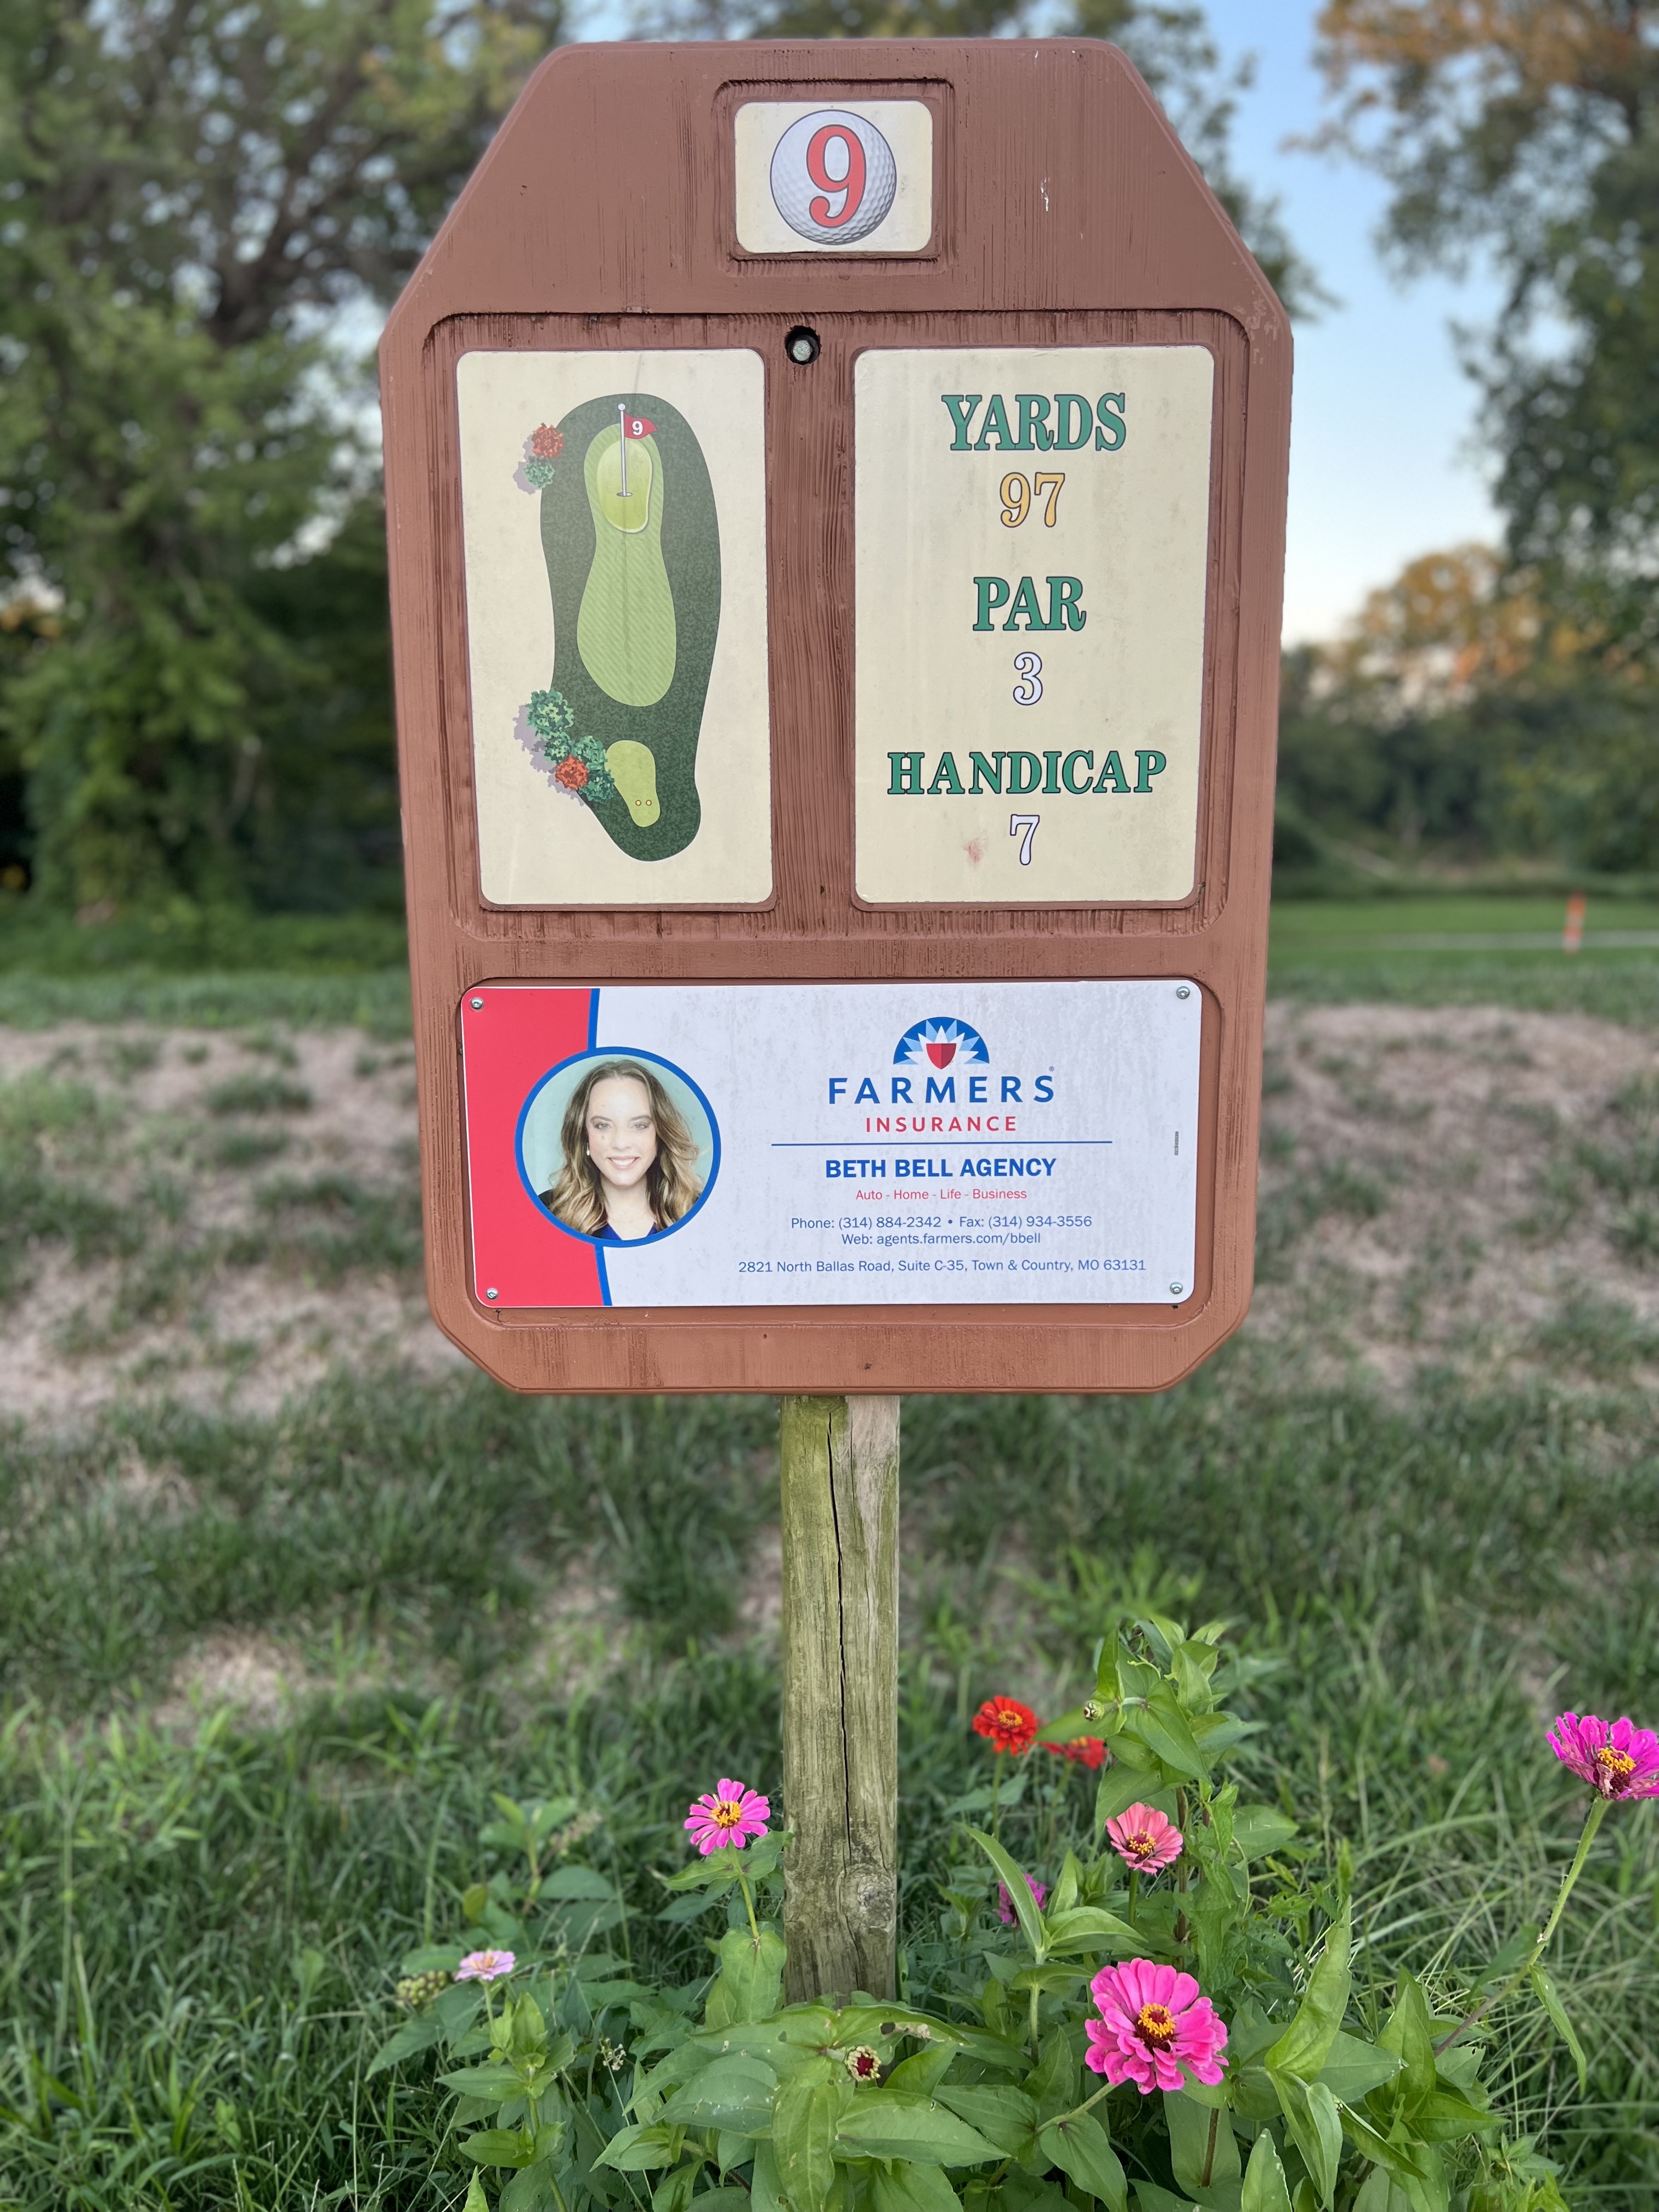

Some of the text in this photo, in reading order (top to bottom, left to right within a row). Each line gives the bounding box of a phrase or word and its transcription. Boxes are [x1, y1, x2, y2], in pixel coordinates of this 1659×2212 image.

[806, 124, 867, 228] 9
[632, 420, 643, 436] 9
[941, 393, 1126, 452] YARDS
[1000, 472, 1065, 528] 97
[973, 577, 1086, 631] PAR
[1013, 652, 1043, 706] 3
[887, 750, 1166, 794] HANDICAP
[1010, 814, 1040, 865] 7
[830, 1076, 1053, 1104] FARMERS
[867, 1116, 1015, 1132] INSURANCE
[826, 1159, 1056, 1177] BETH BELL AGENCY
[856, 1190, 882, 1199] Auto
[894, 1190, 928, 1199] Home
[941, 1189, 961, 1199] Life
[973, 1189, 1027, 1199] Business
[792, 1216, 1092, 1230] Phone: (314) 884-2342 Fax: (314) 934-3556
[842, 1233, 1040, 1246] Web: agents.farmers.com/bbell
[739, 1260, 1146, 1272] 2821 North Ballas Road, Suite C-35, Town & Country, MO 63131
